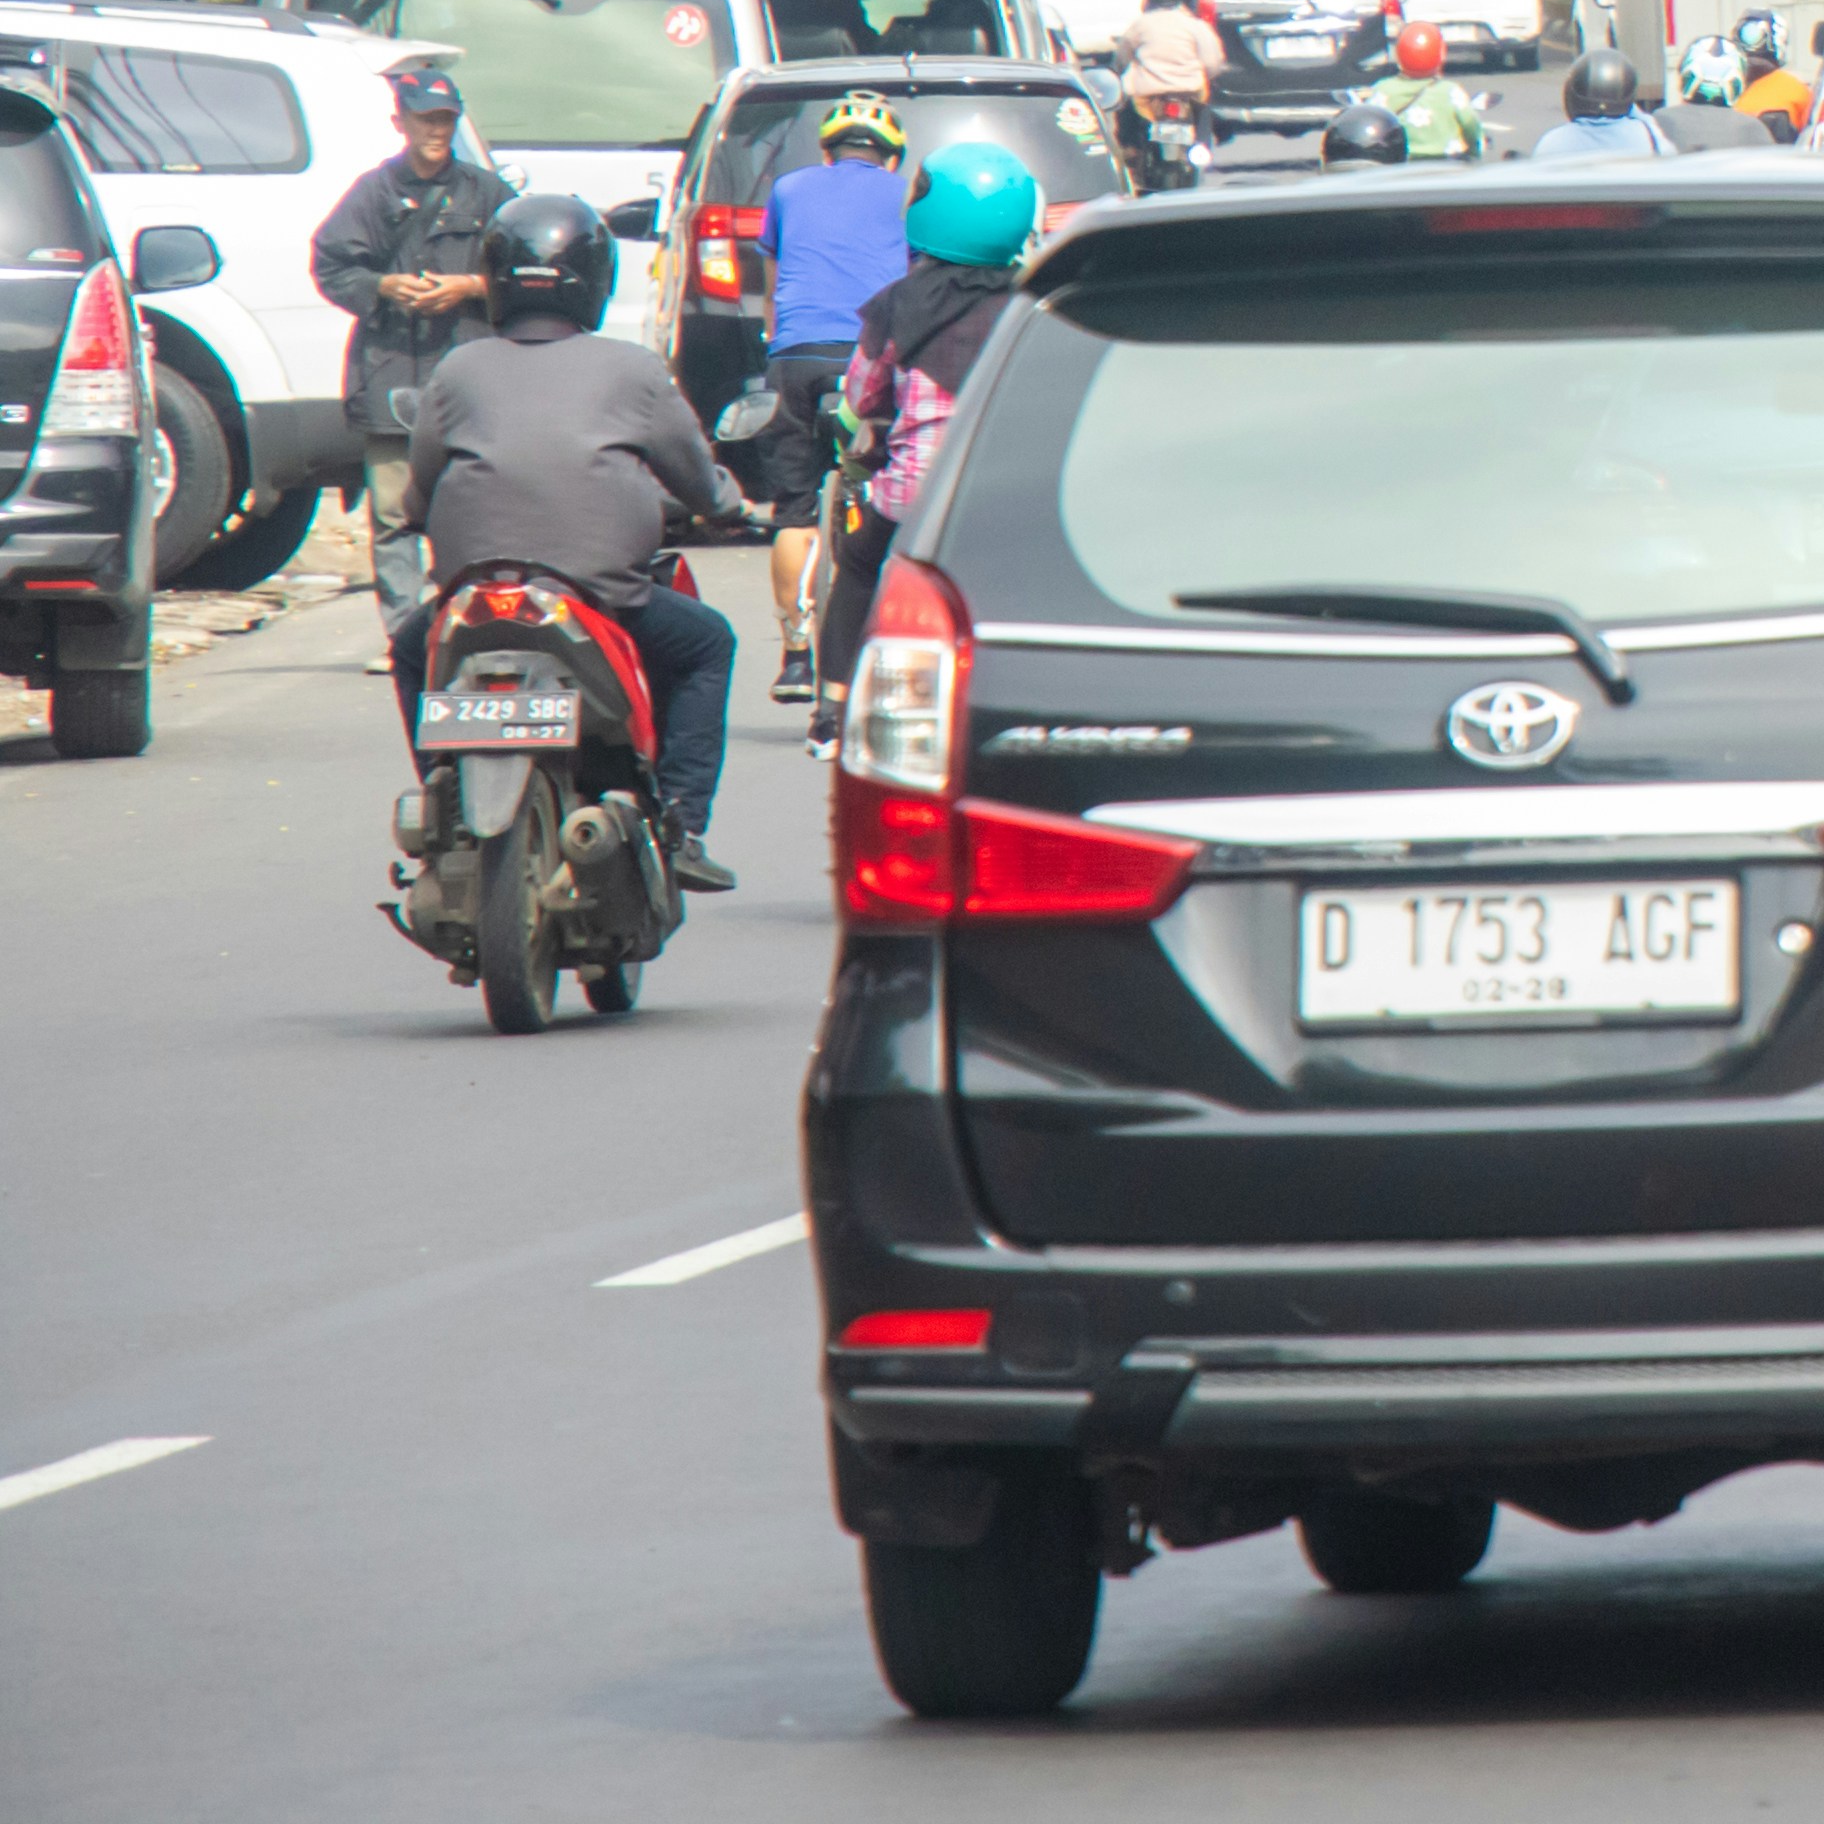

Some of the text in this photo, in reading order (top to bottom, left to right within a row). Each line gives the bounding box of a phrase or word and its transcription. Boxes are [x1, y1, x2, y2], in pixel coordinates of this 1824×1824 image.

[457, 699, 517, 721] 2429
[528, 698, 571, 720] SBC
[1318, 889, 1717, 972] D 1753 AGF
